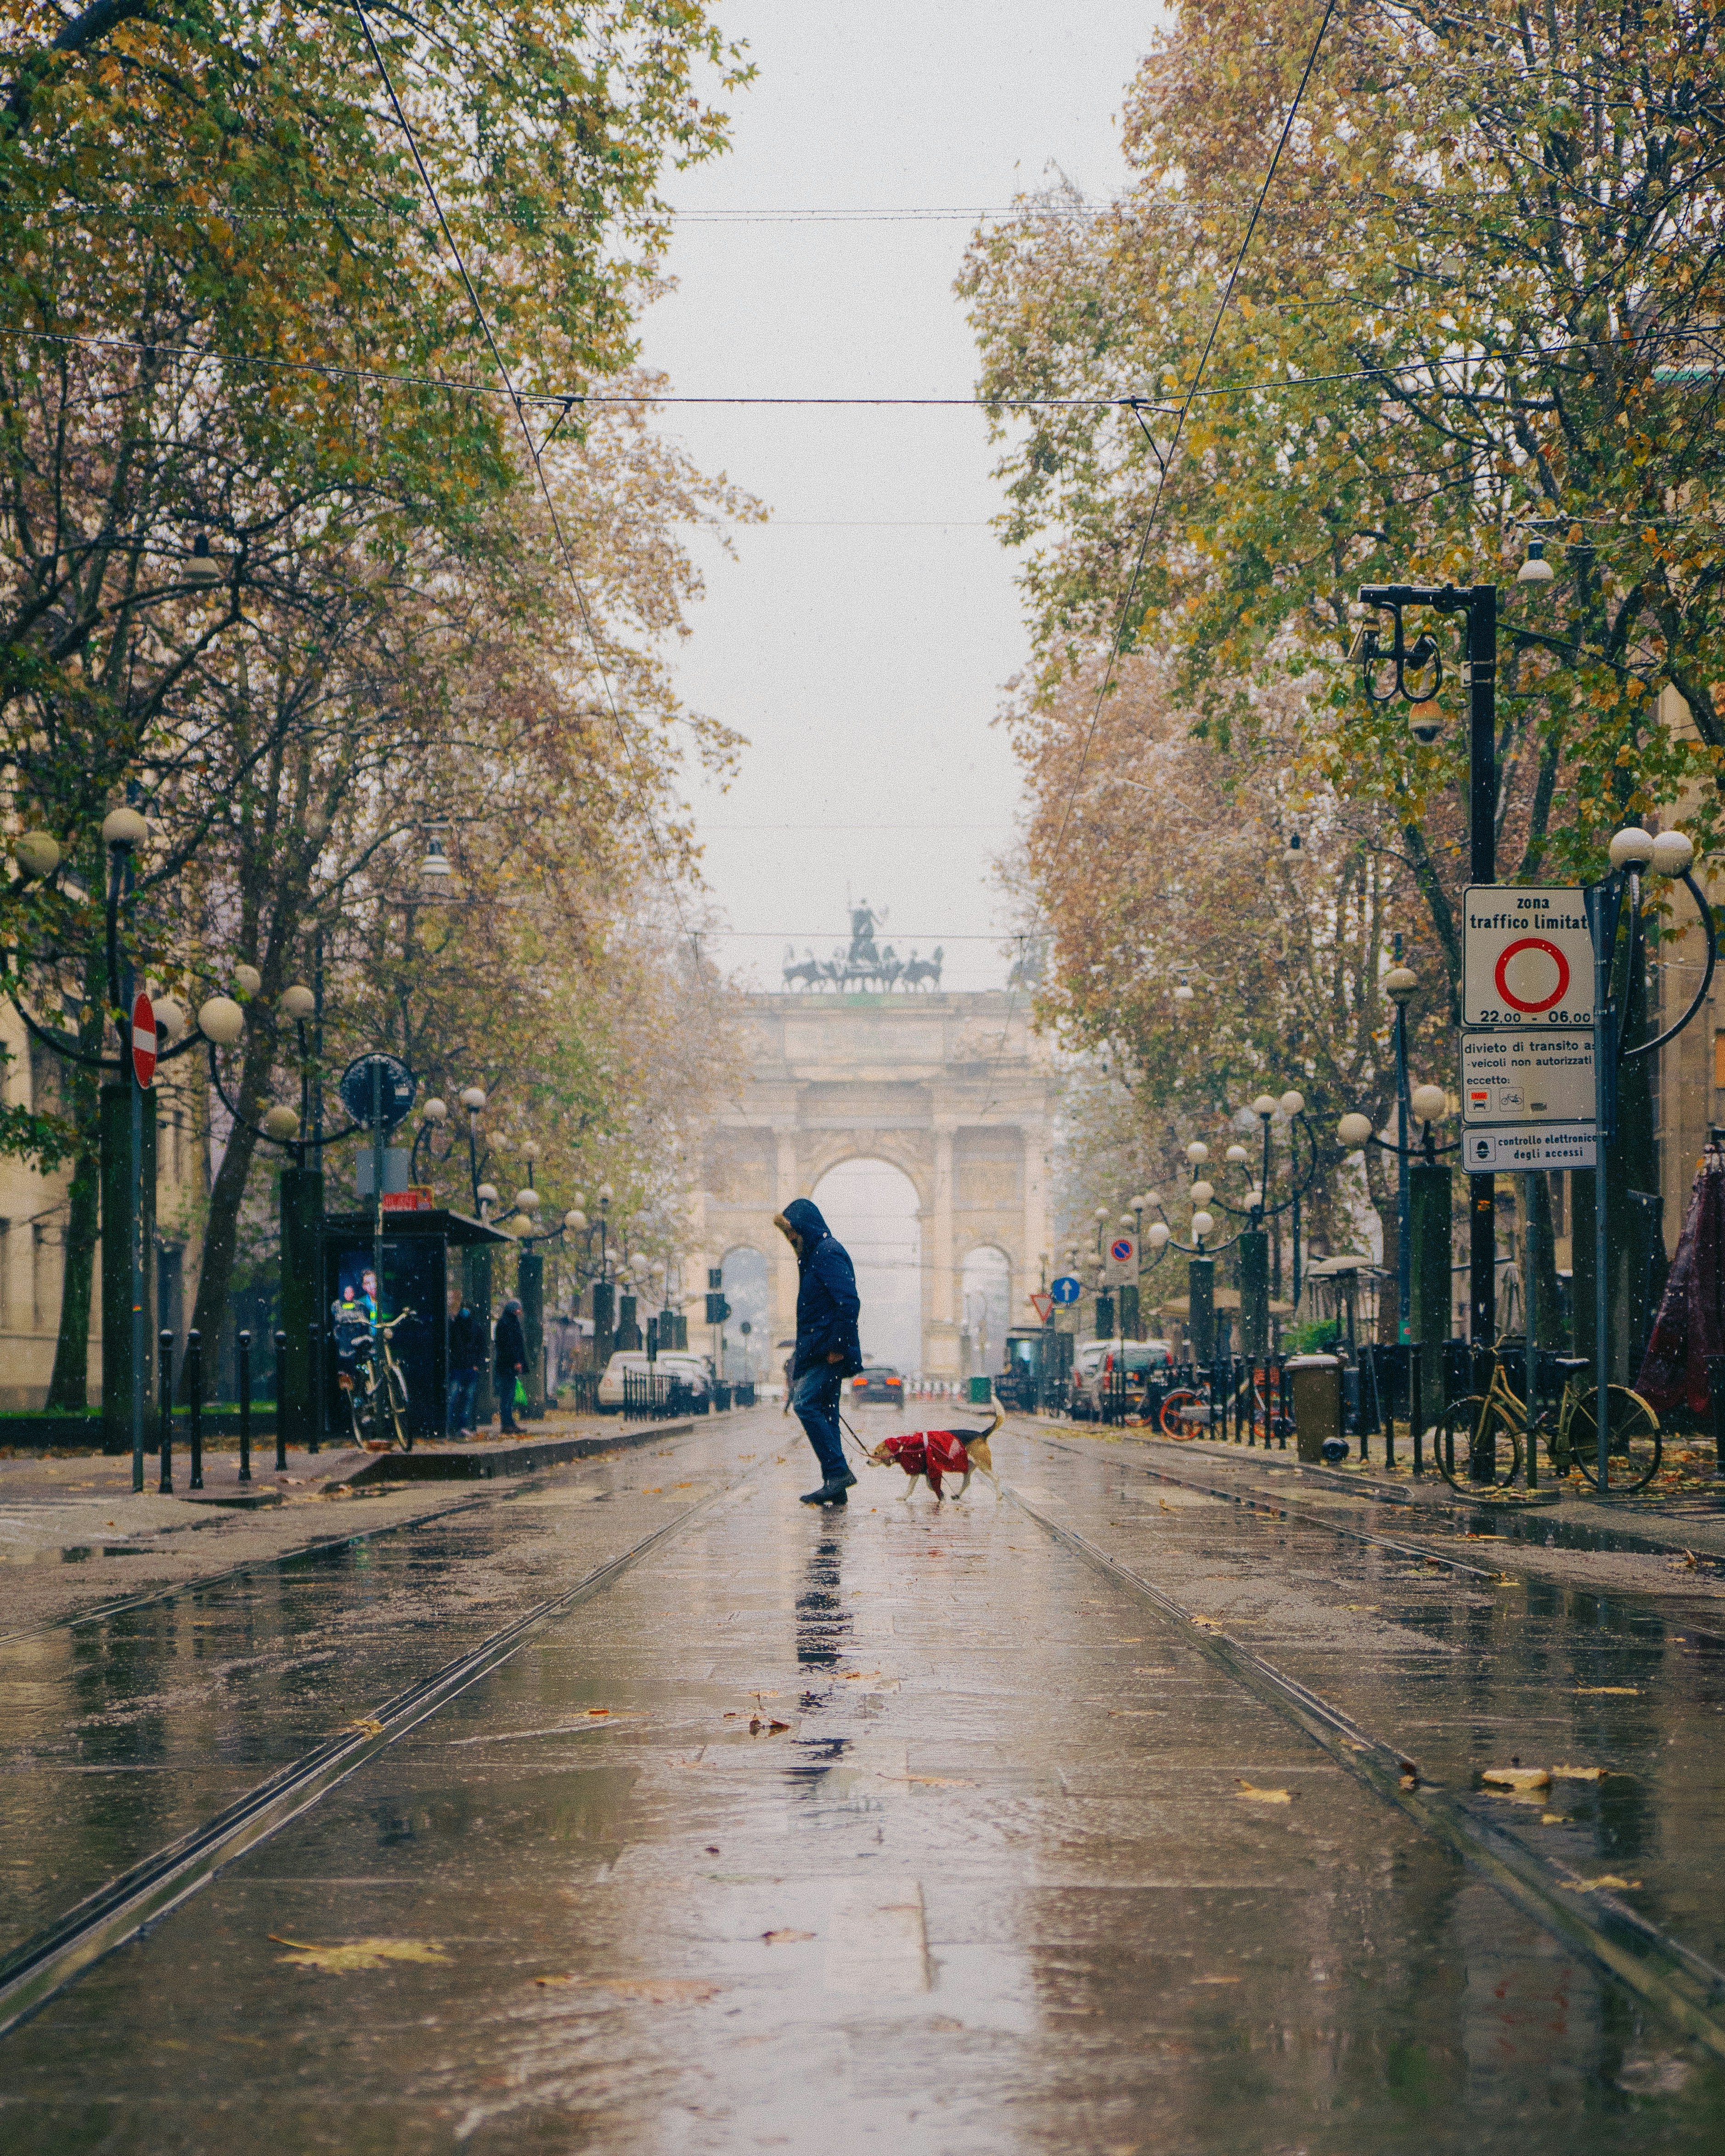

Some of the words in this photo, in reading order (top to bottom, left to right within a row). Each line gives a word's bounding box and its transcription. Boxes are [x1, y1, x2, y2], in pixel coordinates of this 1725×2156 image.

[1517, 898, 1550, 909] zona
[1470, 914, 1529, 929] traffico
[1534, 914, 1588, 929] limitat
[1465, 1042, 1507, 1053] divieto
[1513, 1042, 1524, 1052] di
[1530, 1041, 1578, 1052] transito
[1536, 1056, 1591, 1066] autorizzati
[1498, 1135, 1542, 1146] controllo
[1514, 1149, 1540, 1160] degli
[1545, 1147, 1583, 1158] accessi
